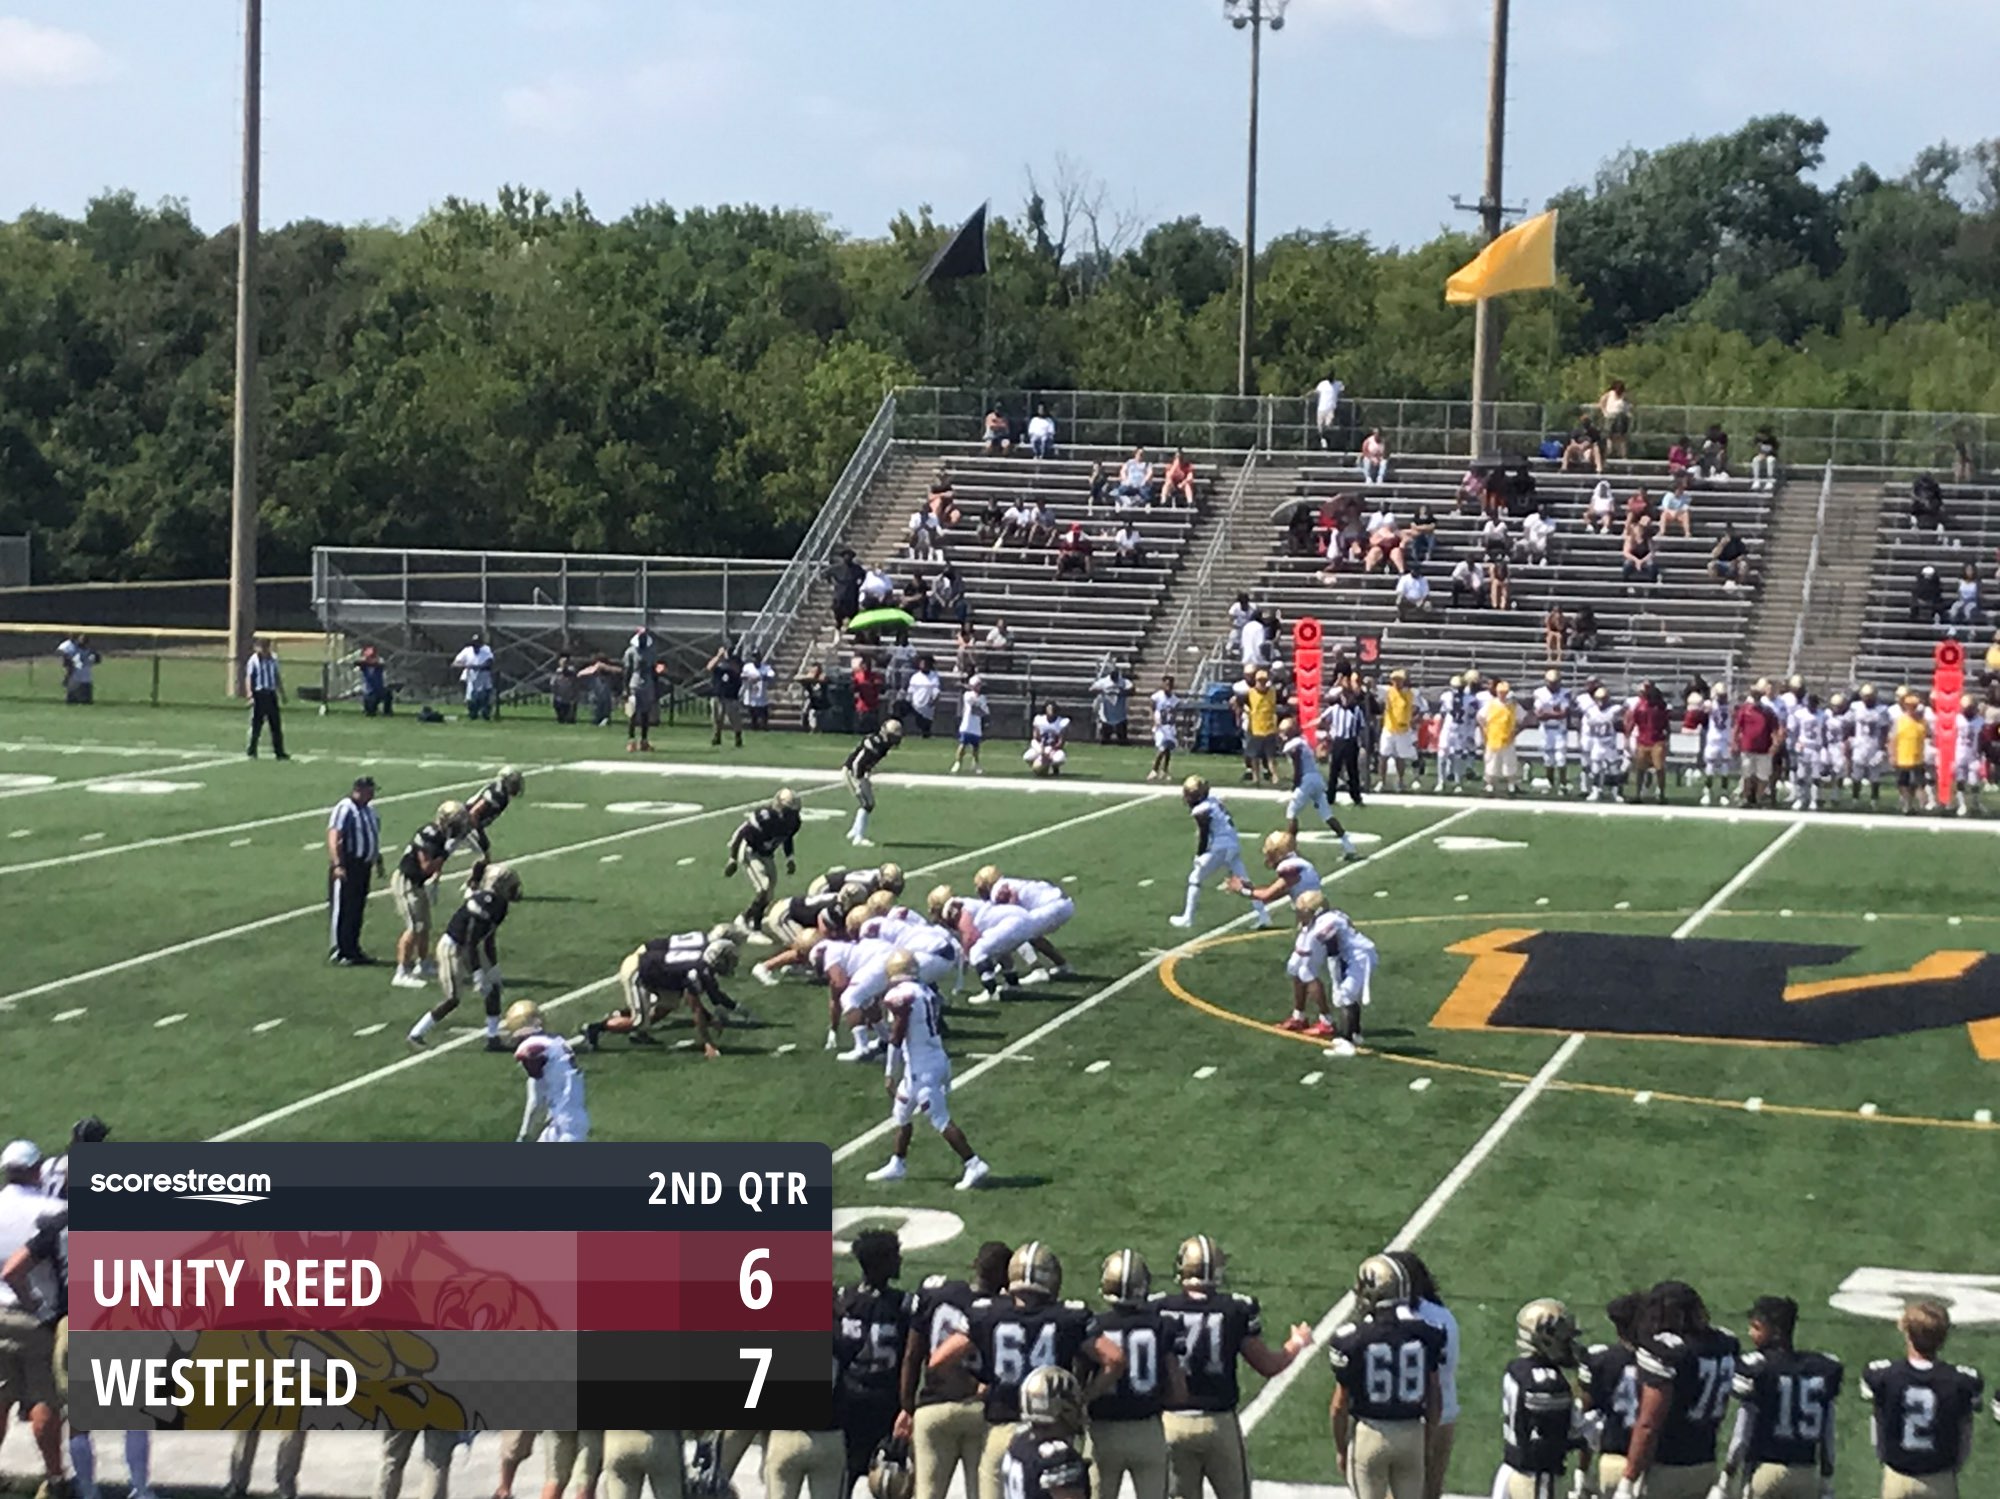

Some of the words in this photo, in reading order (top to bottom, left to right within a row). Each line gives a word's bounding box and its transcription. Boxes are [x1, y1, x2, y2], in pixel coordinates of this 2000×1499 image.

[1360, 638, 1378, 662] 3
[994, 1322, 1056, 1382] 64
[1366, 1340, 1425, 1402] 68
[1774, 1375, 1824, 1438] 15
[1902, 1386, 1936, 1449] 2
